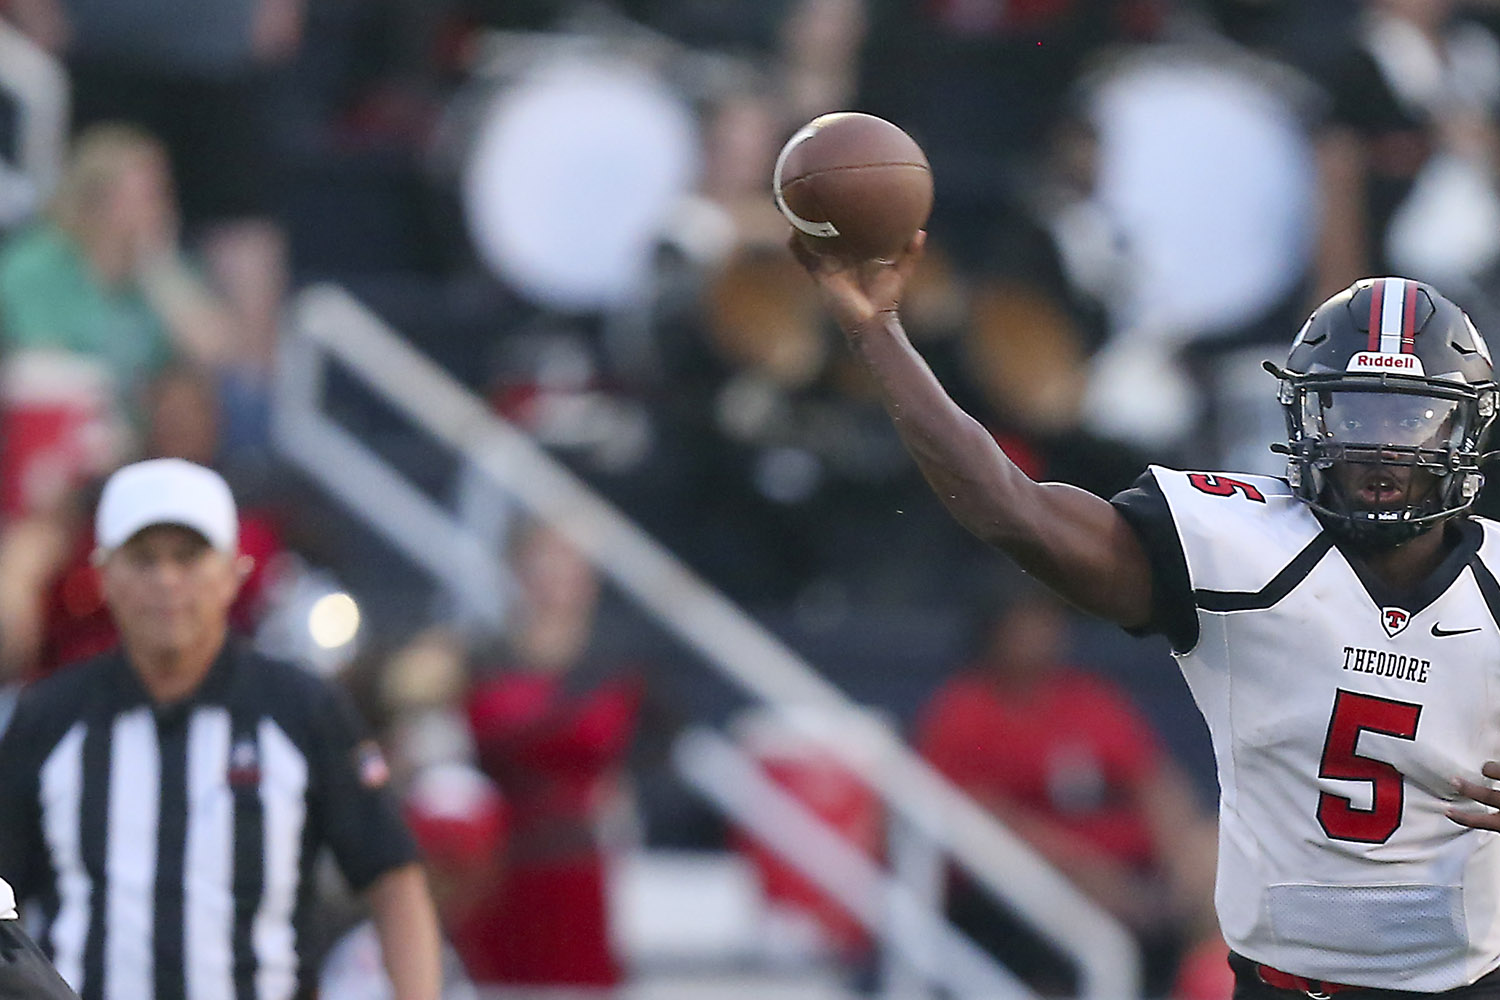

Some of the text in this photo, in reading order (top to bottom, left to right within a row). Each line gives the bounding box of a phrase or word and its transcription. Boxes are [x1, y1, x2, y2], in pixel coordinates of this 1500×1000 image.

[1357, 355, 1413, 368] Riddell
[1186, 473, 1266, 503] 5
[1343, 646, 1430, 683] THEODORE
[1316, 687, 1423, 845] 5
